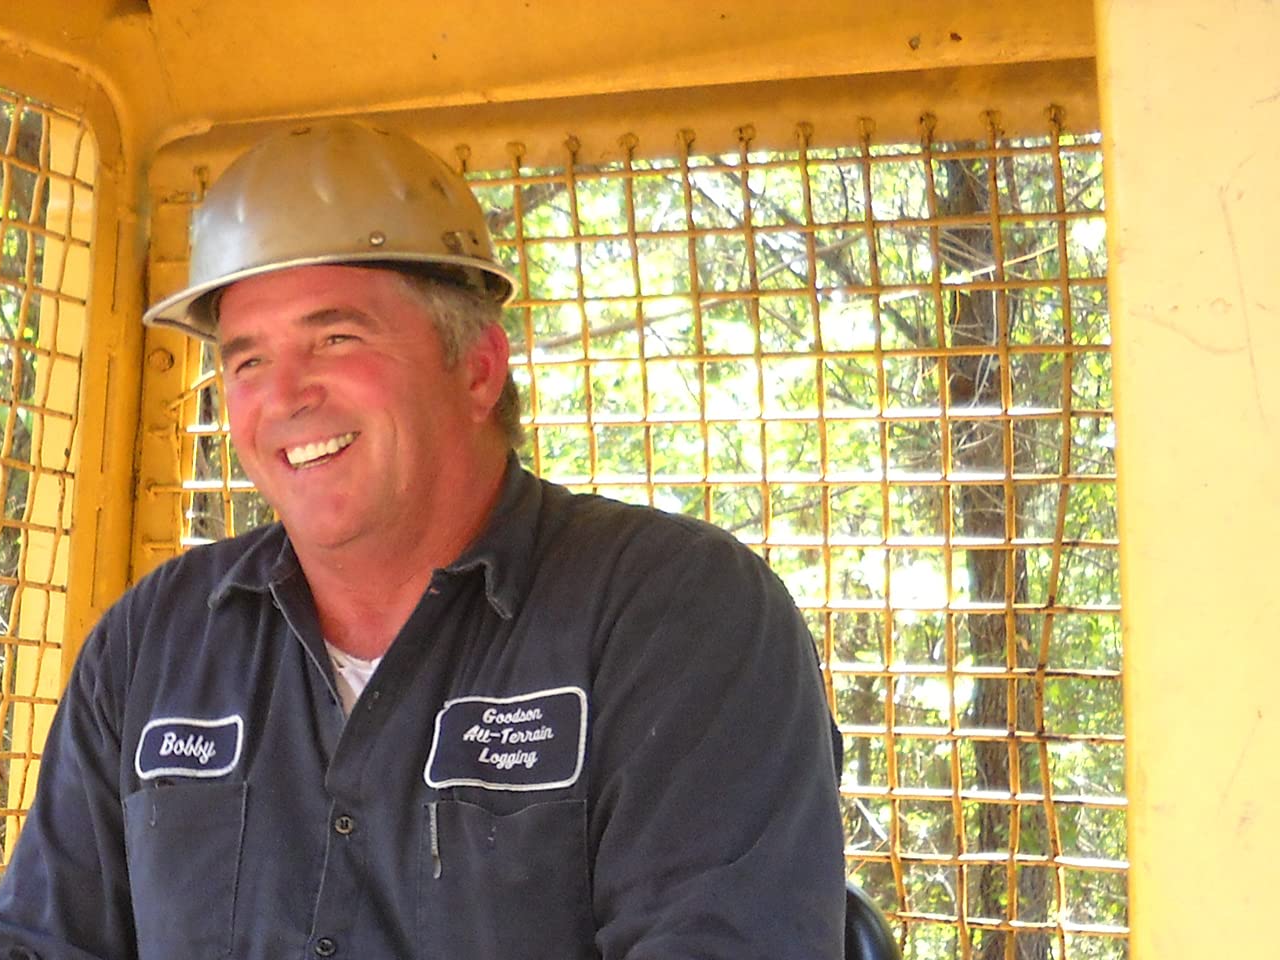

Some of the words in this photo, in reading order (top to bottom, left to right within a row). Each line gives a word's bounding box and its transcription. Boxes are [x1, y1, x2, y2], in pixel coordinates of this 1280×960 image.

[482, 708, 543, 724] Goodson
[463, 725, 554, 744] All-Terrain
[159, 731, 217, 765] Bobby
[478, 747, 539, 770] Logging
